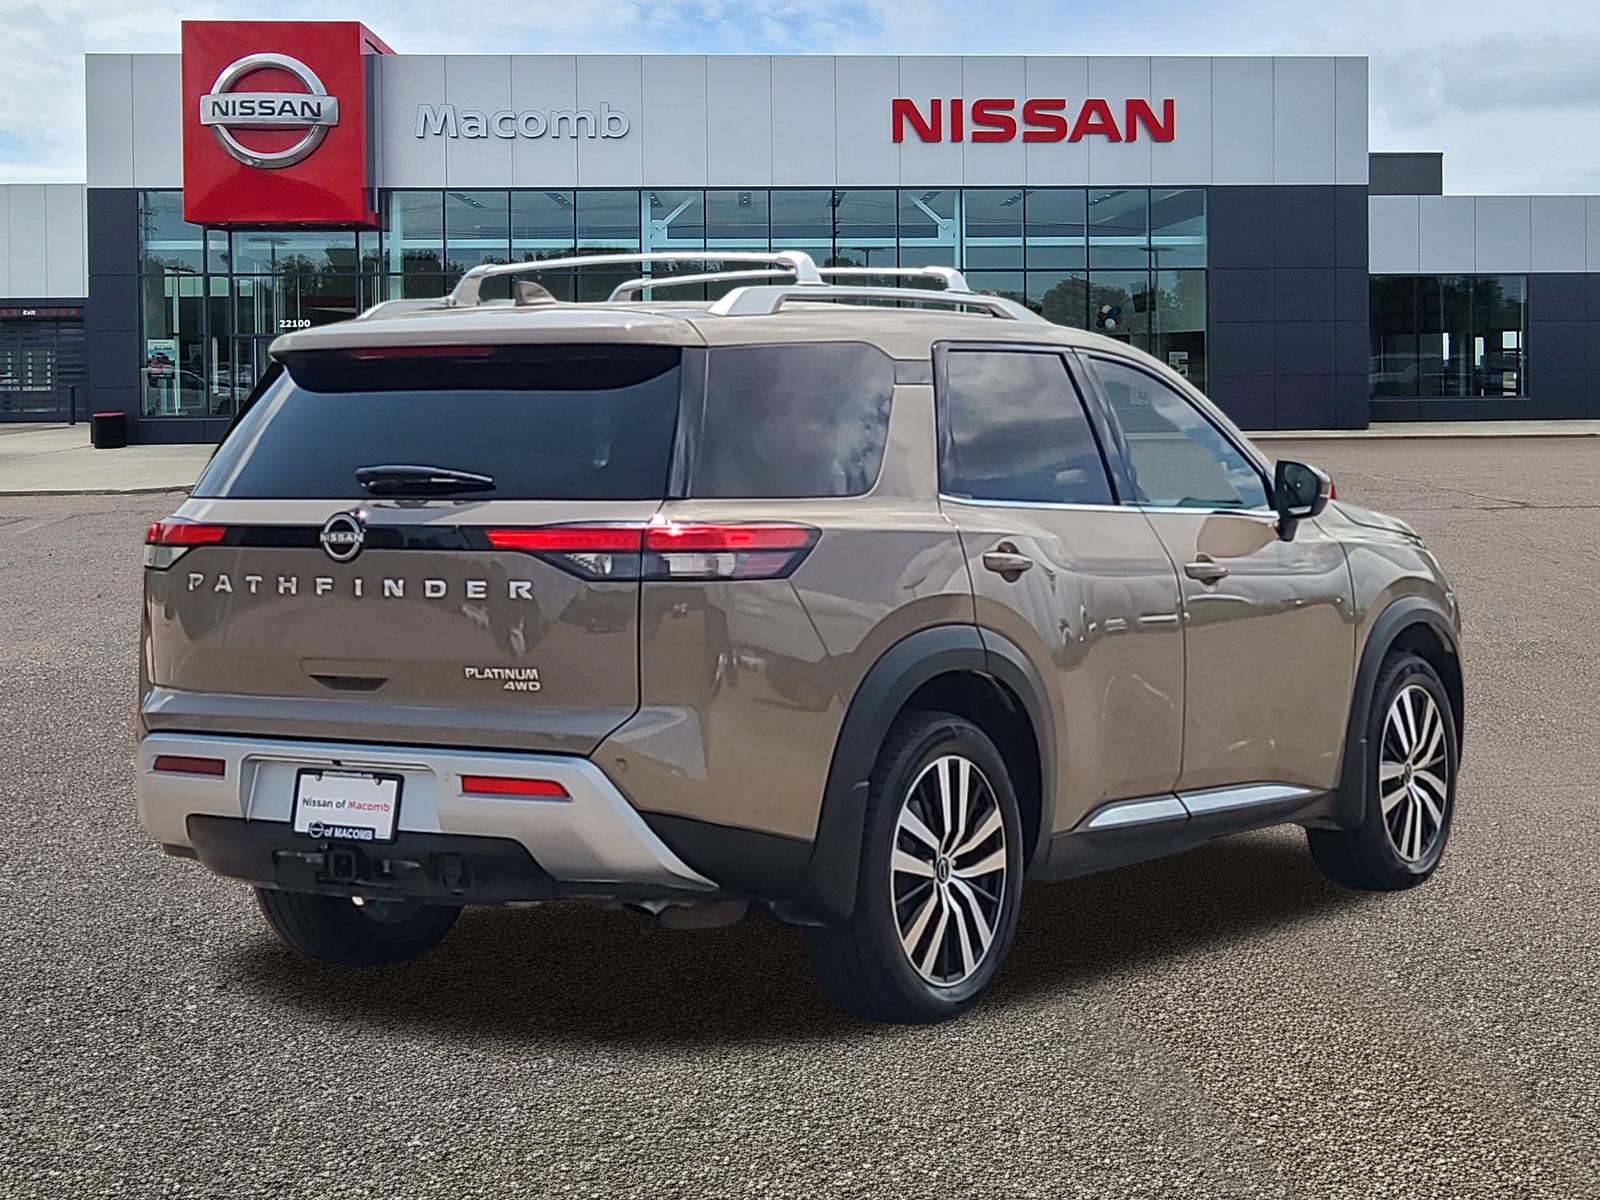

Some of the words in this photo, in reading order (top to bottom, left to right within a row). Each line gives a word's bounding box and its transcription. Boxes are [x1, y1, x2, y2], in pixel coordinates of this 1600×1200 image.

[211, 100, 322, 118] NISSAN
[415, 102, 630, 139] Macomb
[892, 98, 1175, 142] NISSAN
[279, 319, 311, 328] 22100
[320, 533, 364, 542] NISSAN
[187, 573, 533, 600] PATHFINDER
[464, 667, 539, 680] PLATINUM
[503, 681, 541, 691] 4WD
[302, 797, 333, 809] Nissan
[335, 800, 346, 809] of
[347, 801, 390, 813] Macomb
[324, 827, 332, 837] of
[334, 827, 373, 840] MACOMB
